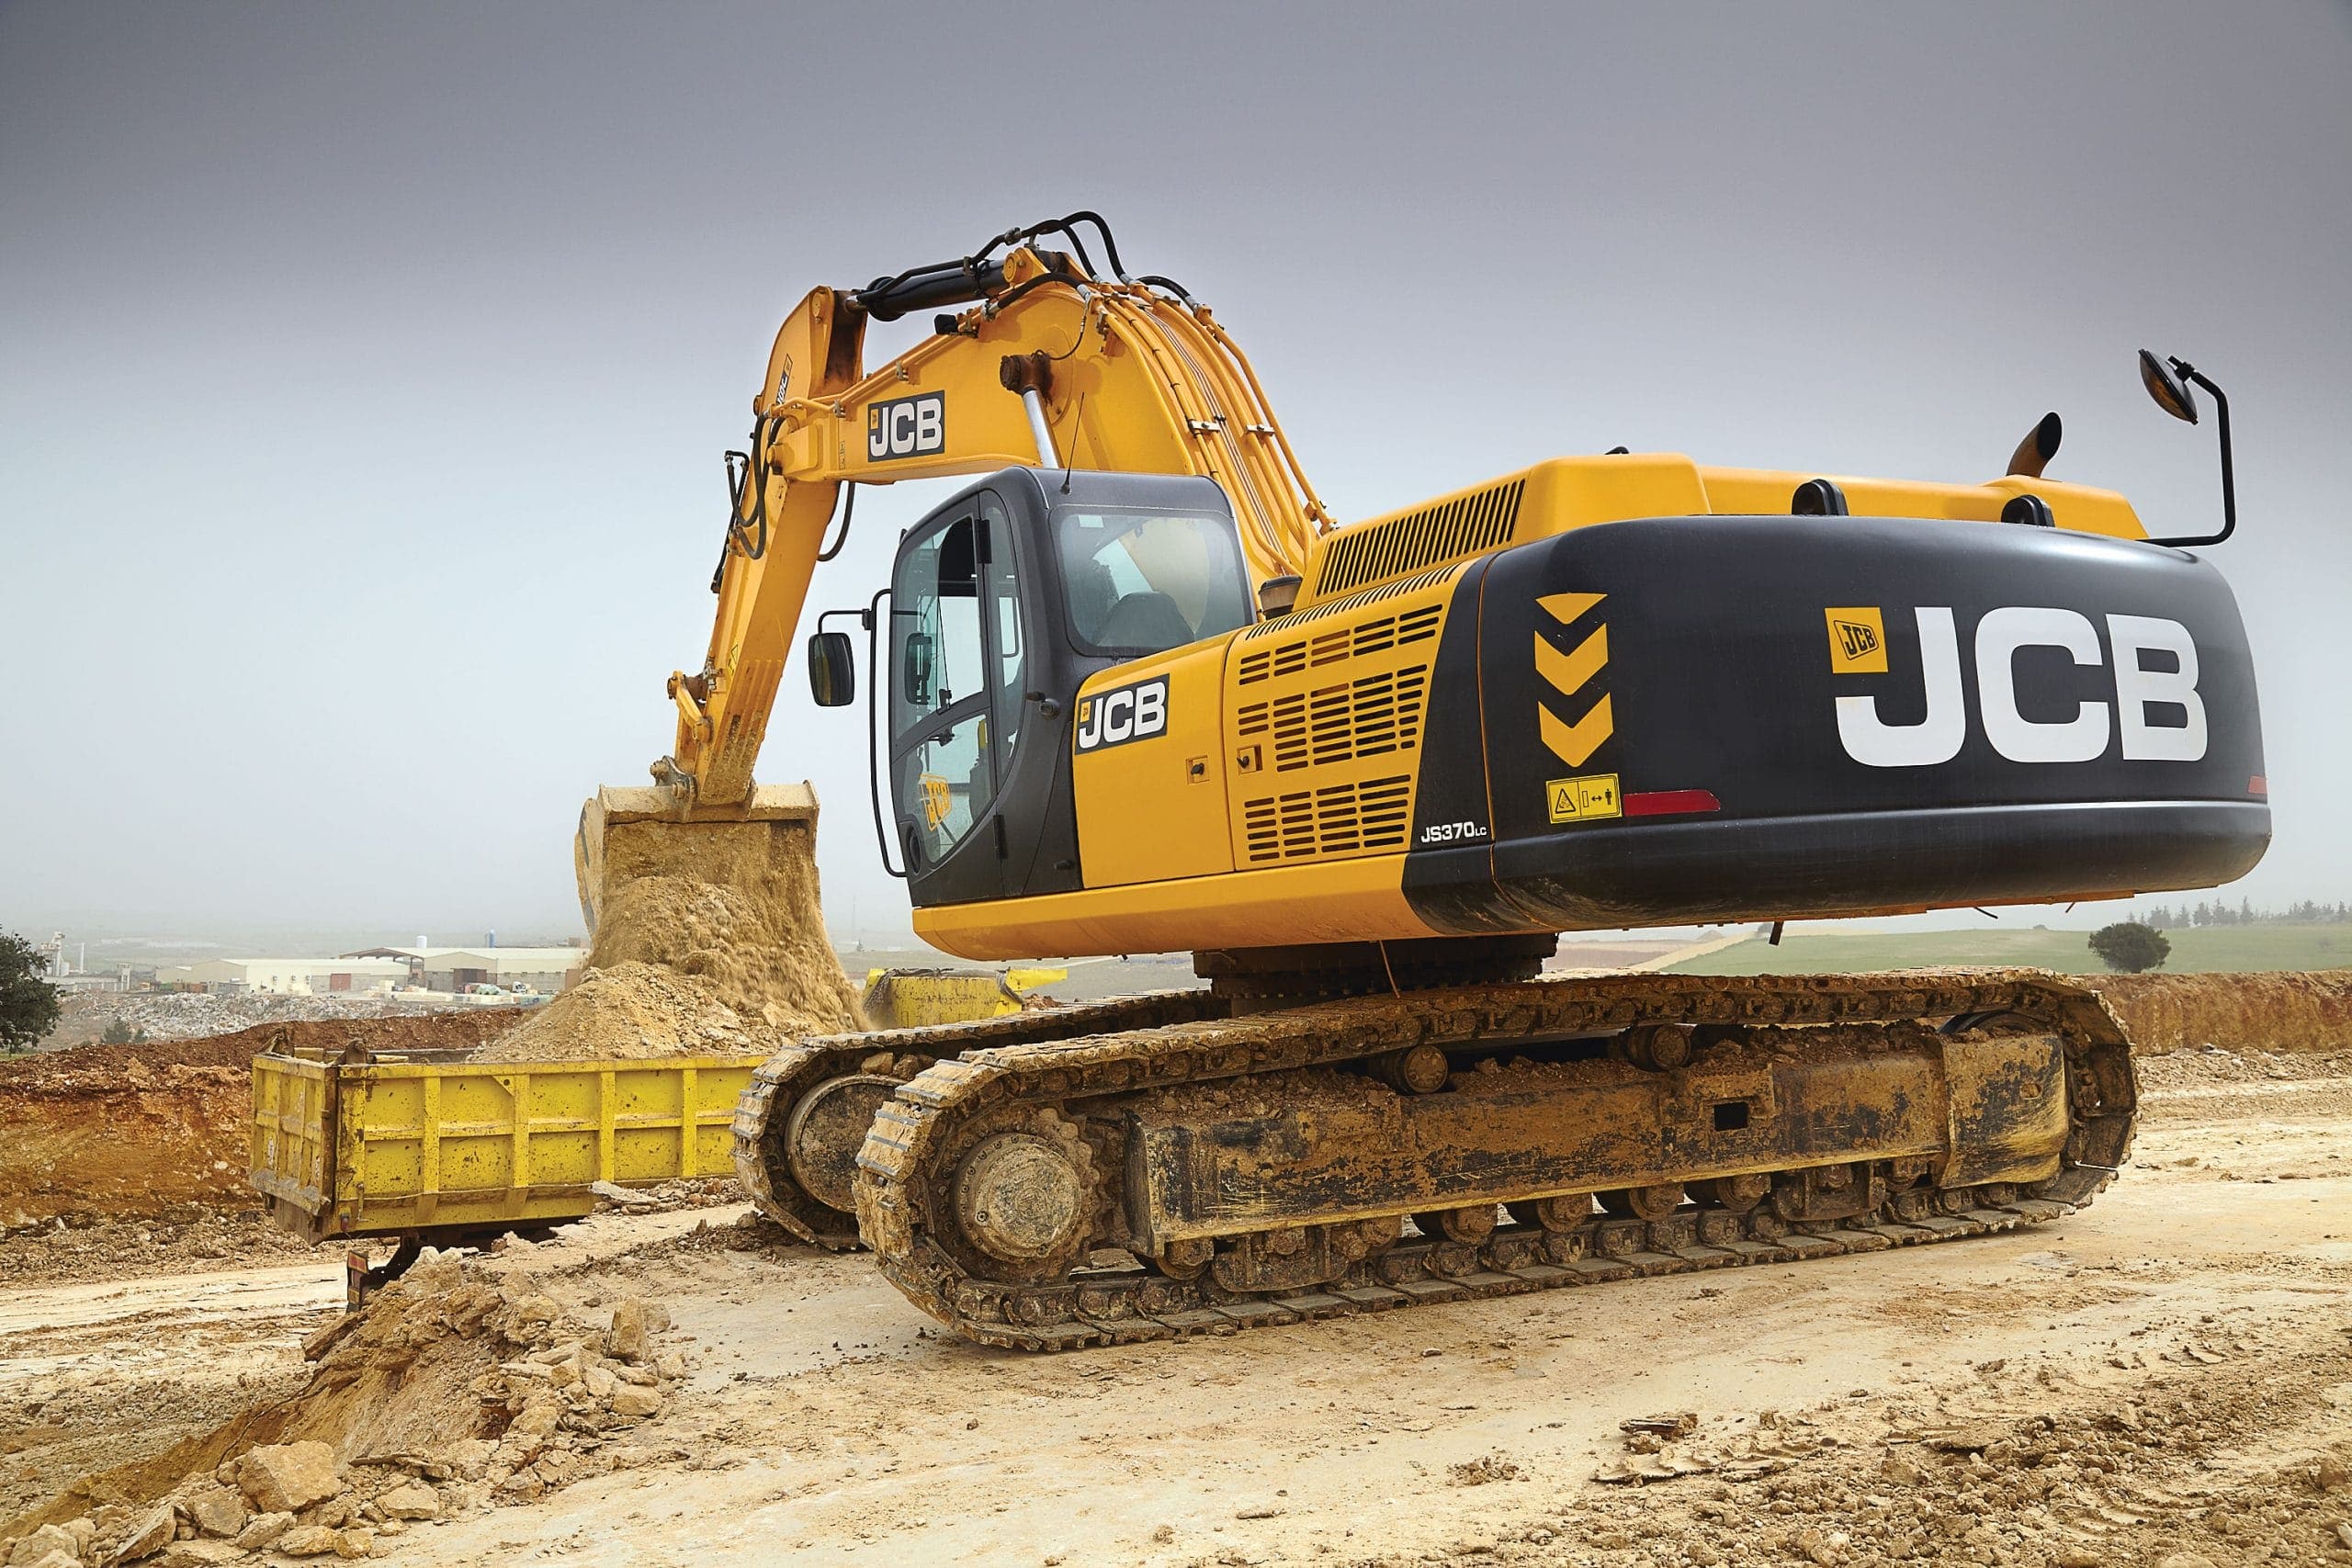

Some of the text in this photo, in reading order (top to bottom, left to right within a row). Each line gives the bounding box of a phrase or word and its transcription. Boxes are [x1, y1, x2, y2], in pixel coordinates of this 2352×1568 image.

[870, 398, 943, 457] JCB
[1842, 625, 1876, 655] JCB
[1079, 682, 1166, 749] JCB
[1835, 606, 2208, 767] JCB
